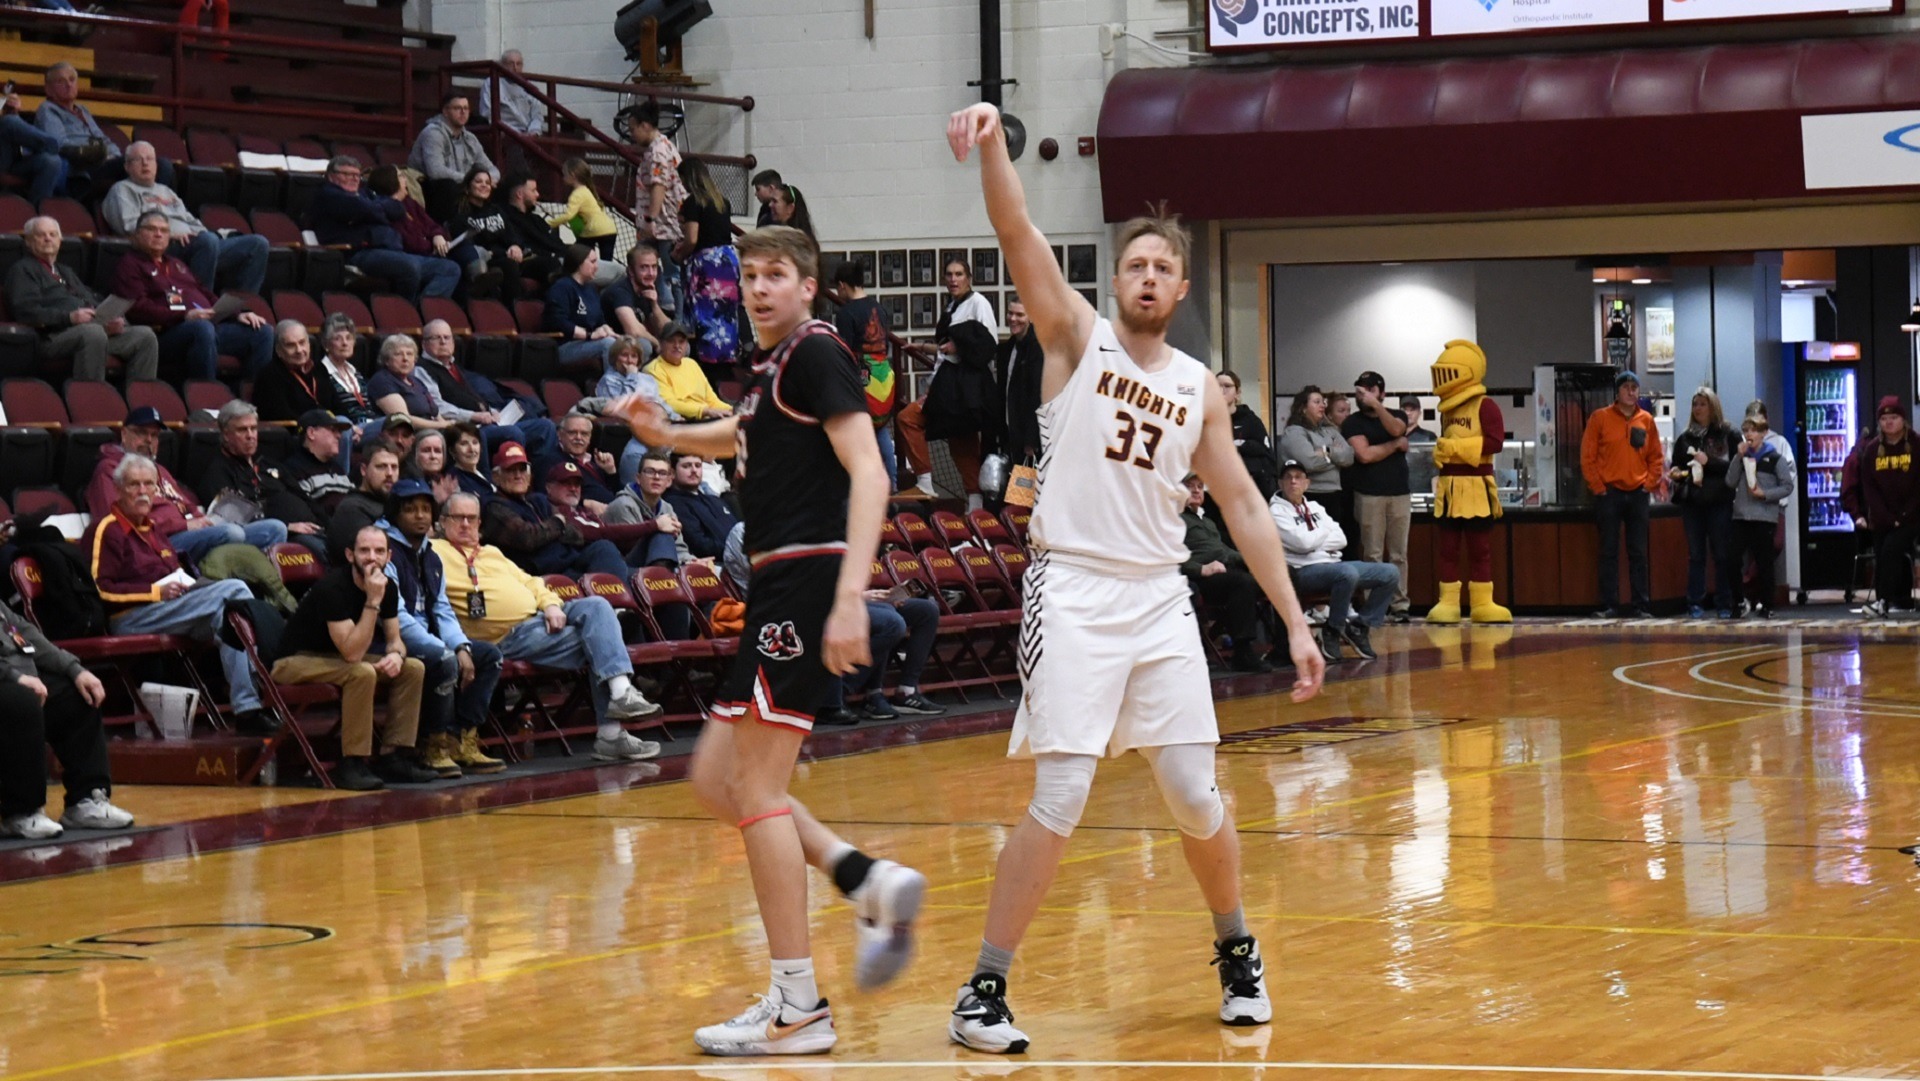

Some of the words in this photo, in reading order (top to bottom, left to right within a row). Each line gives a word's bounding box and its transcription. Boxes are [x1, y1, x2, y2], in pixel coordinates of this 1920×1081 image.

[1263, 8, 1374, 37] CONCEPTS,
[1379, 5, 1419, 29] INC.
[1512, 15, 1561, 24] Orthopaedic
[1096, 370, 1188, 427] KNIGHTS
[1105, 410, 1163, 470] 33
[591, 581, 626, 594] GANNON
[643, 578, 679, 591] GANNON
[686, 575, 718, 587] GANNON
[196, 757, 226, 776] AA
